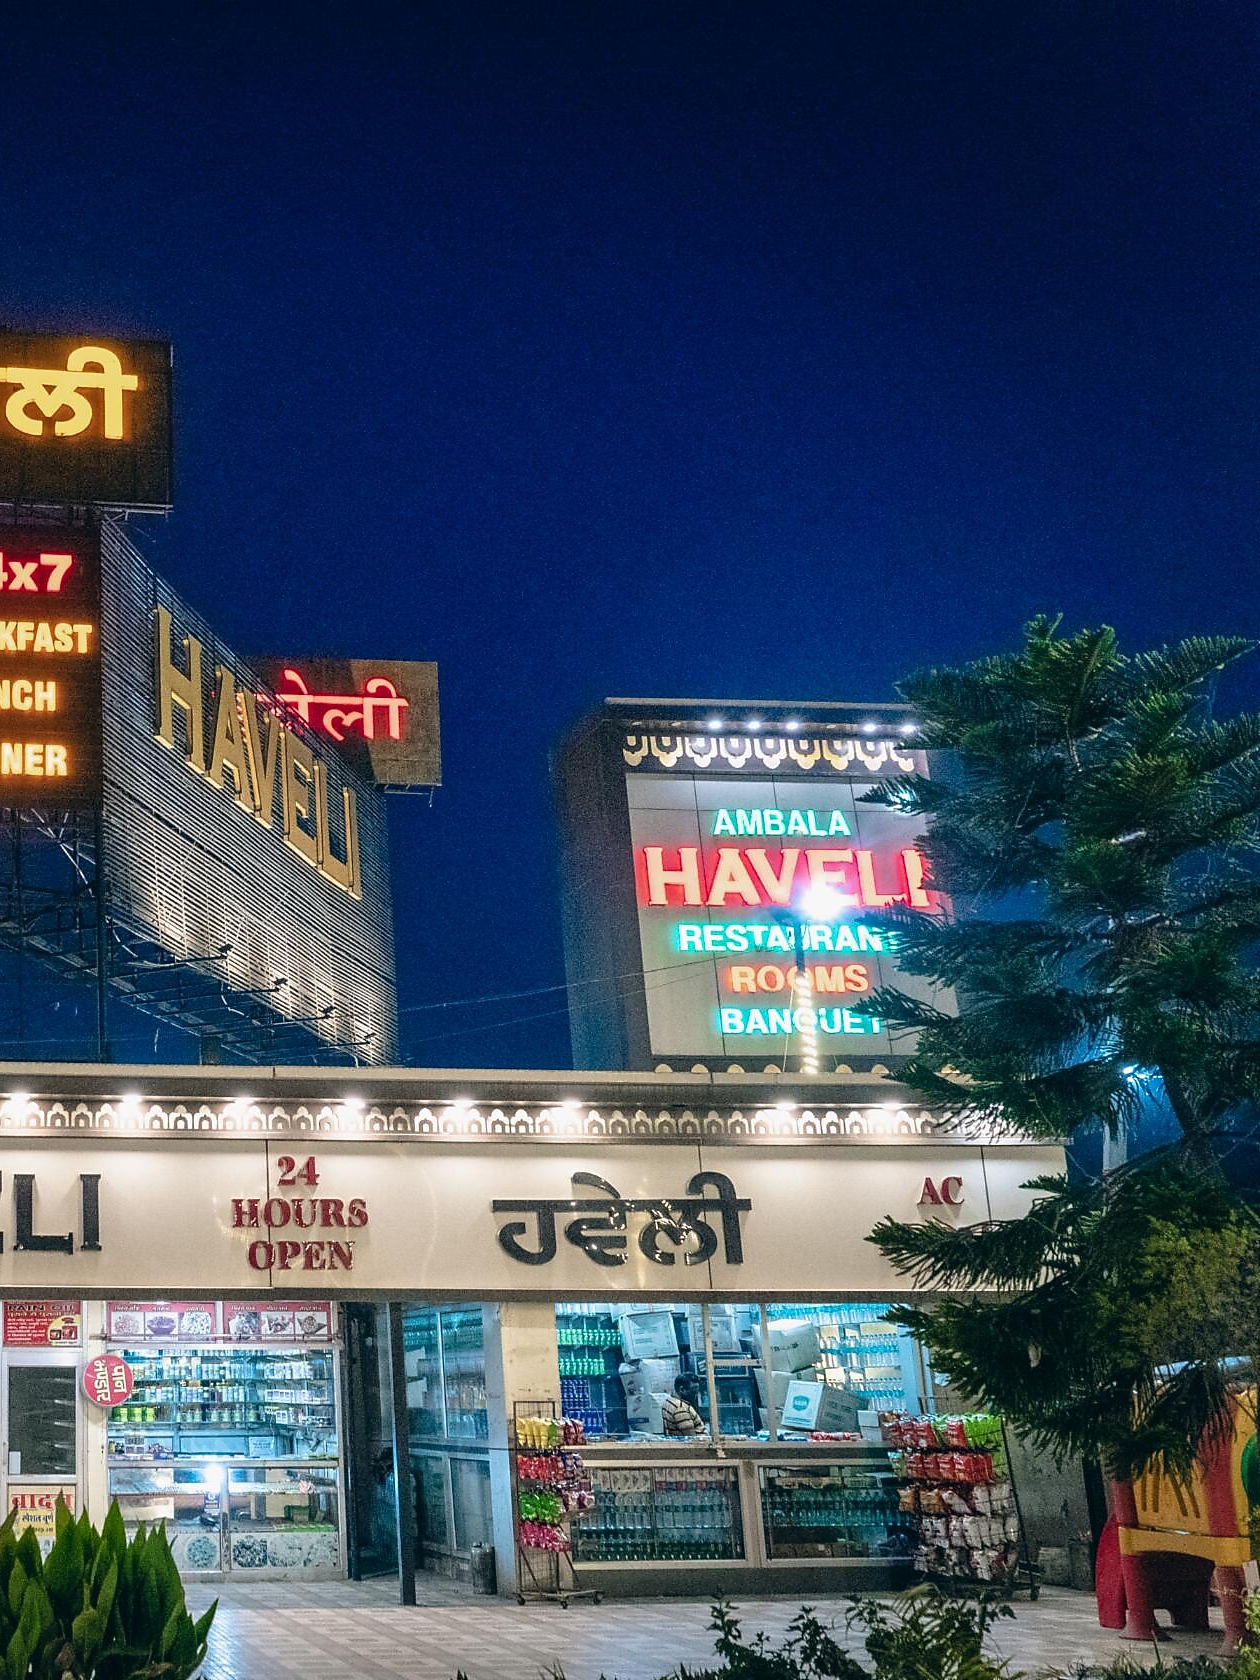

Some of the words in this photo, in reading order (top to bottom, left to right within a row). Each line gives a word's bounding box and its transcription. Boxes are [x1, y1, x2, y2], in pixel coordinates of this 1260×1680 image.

[153, 604, 362, 901] HAVELI
[713, 808, 852, 837] AMBALA
[643, 847, 931, 908] HAVELI
[730, 964, 869, 994] ROOMS
[276, 1155, 321, 1186] 24
[917, 1176, 966, 1205] AC
[231, 1198, 369, 1229] HOURS
[492, 1171, 752, 1266] ਹਵੇਲੀ
[247, 1240, 355, 1271] OPEN
